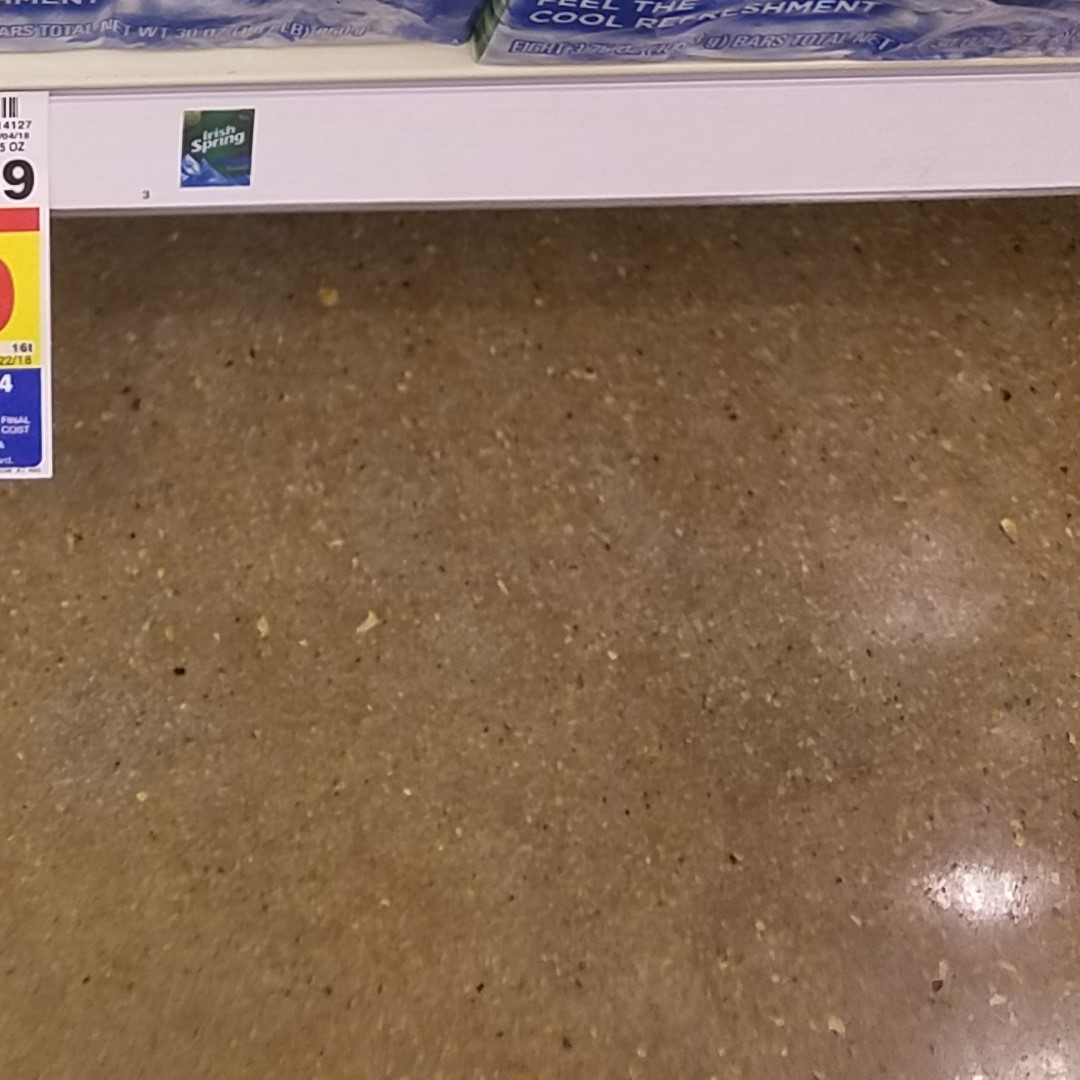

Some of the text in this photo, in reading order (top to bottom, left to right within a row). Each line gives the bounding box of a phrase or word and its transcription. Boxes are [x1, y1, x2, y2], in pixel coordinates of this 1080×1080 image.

[528, 10, 623, 29] COOL
[39, 23, 94, 38] TOTAL
[732, 33, 786, 49] BARS
[202, 124, 236, 142] Irish
[9, 141, 25, 152] OZ
[191, 131, 245, 153] Spring
